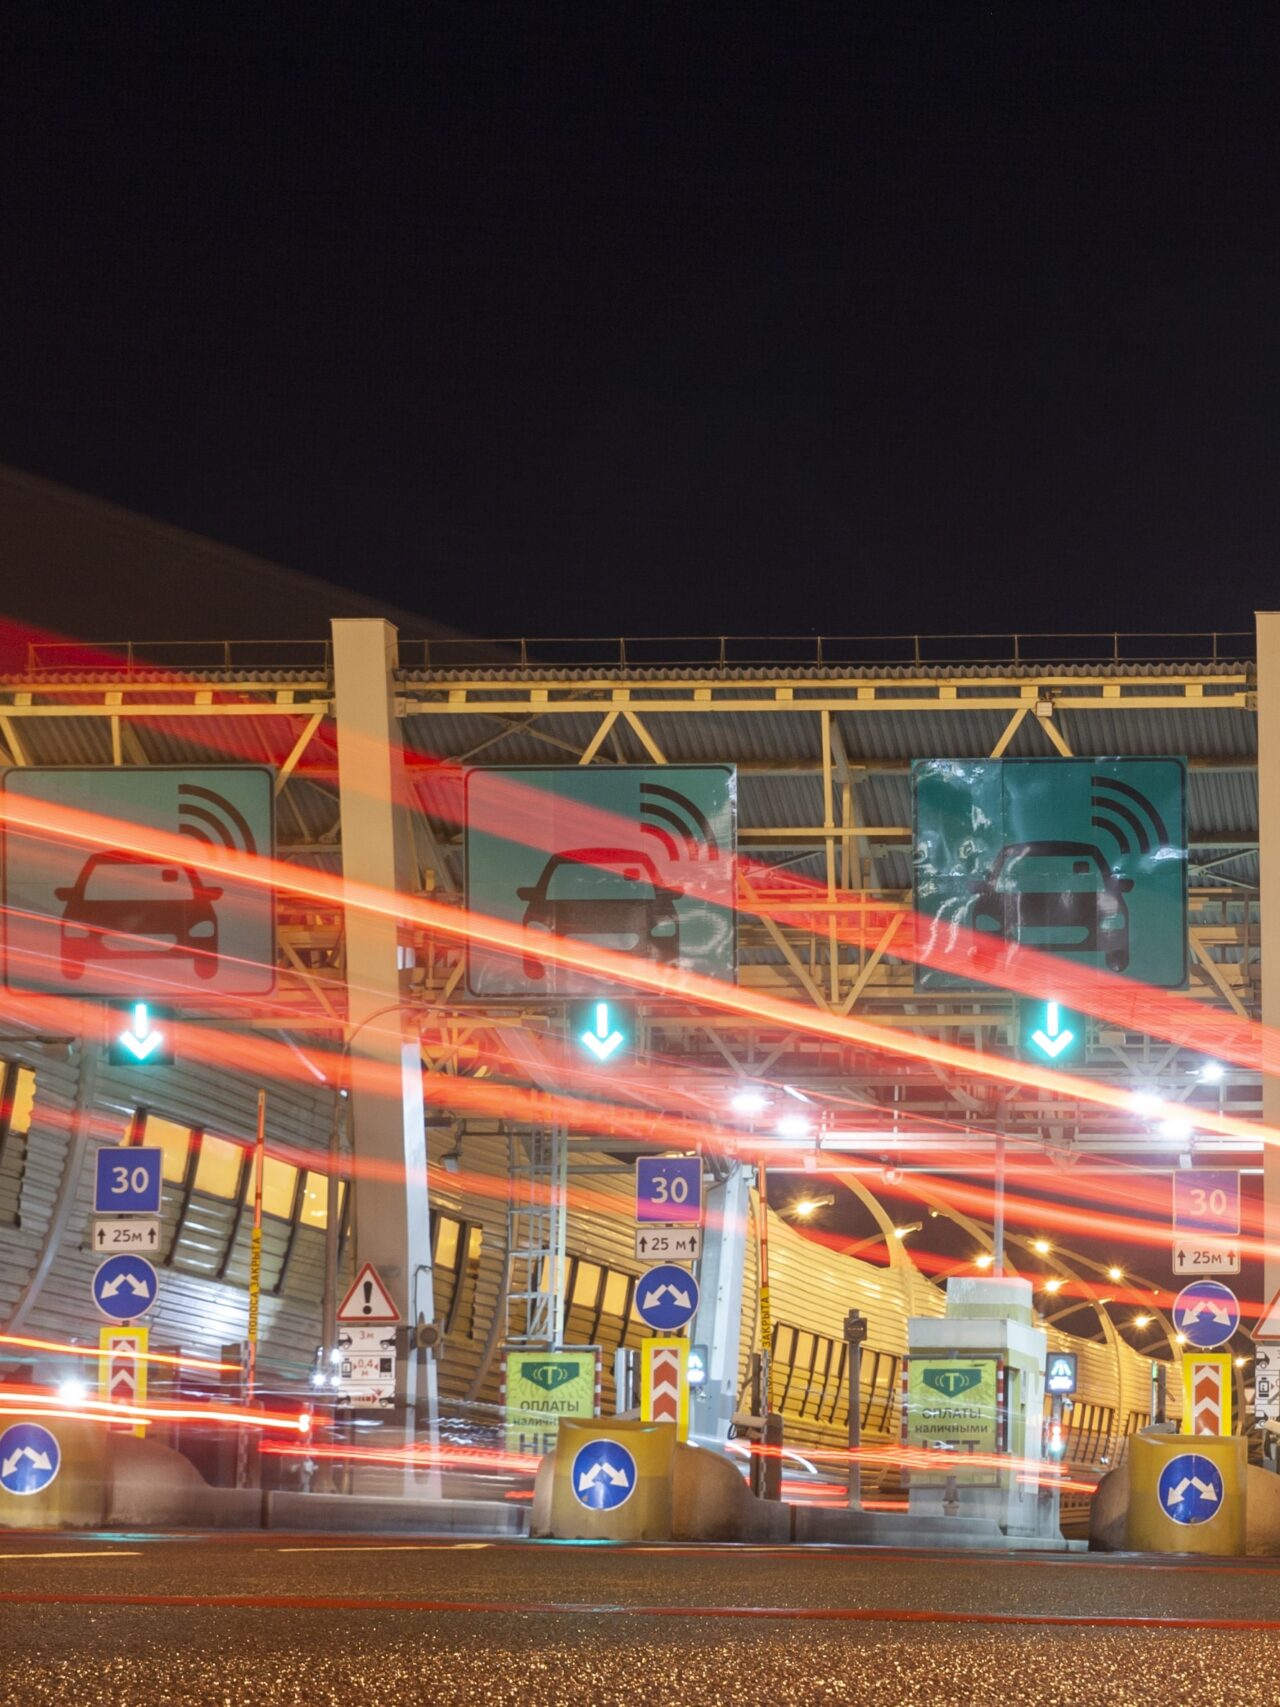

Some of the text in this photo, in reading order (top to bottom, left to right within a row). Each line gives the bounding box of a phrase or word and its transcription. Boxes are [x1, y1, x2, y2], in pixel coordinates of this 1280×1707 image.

[111, 1166, 149, 1194] 30
[651, 1177, 688, 1204] 30
[1189, 1188, 1227, 1215] 30
[112, 1229, 143, 1243] 25м
[1192, 1251, 1222, 1264] 25м
[248, 1238, 261, 1334] ПОЛОСА ЗАКРЫТА
[761, 1296, 771, 1347] ЗАКРЫТА
[357, 1359, 373, 1369] 0,4
[520, 1400, 579, 1412] ОПЛАТЫ
[922, 1407, 981, 1420] ОПЛАТЫ
[513, 1416, 557, 1426] наличн
[915, 1425, 988, 1433] наличными
[519, 1432, 557, 1456] НЕ
